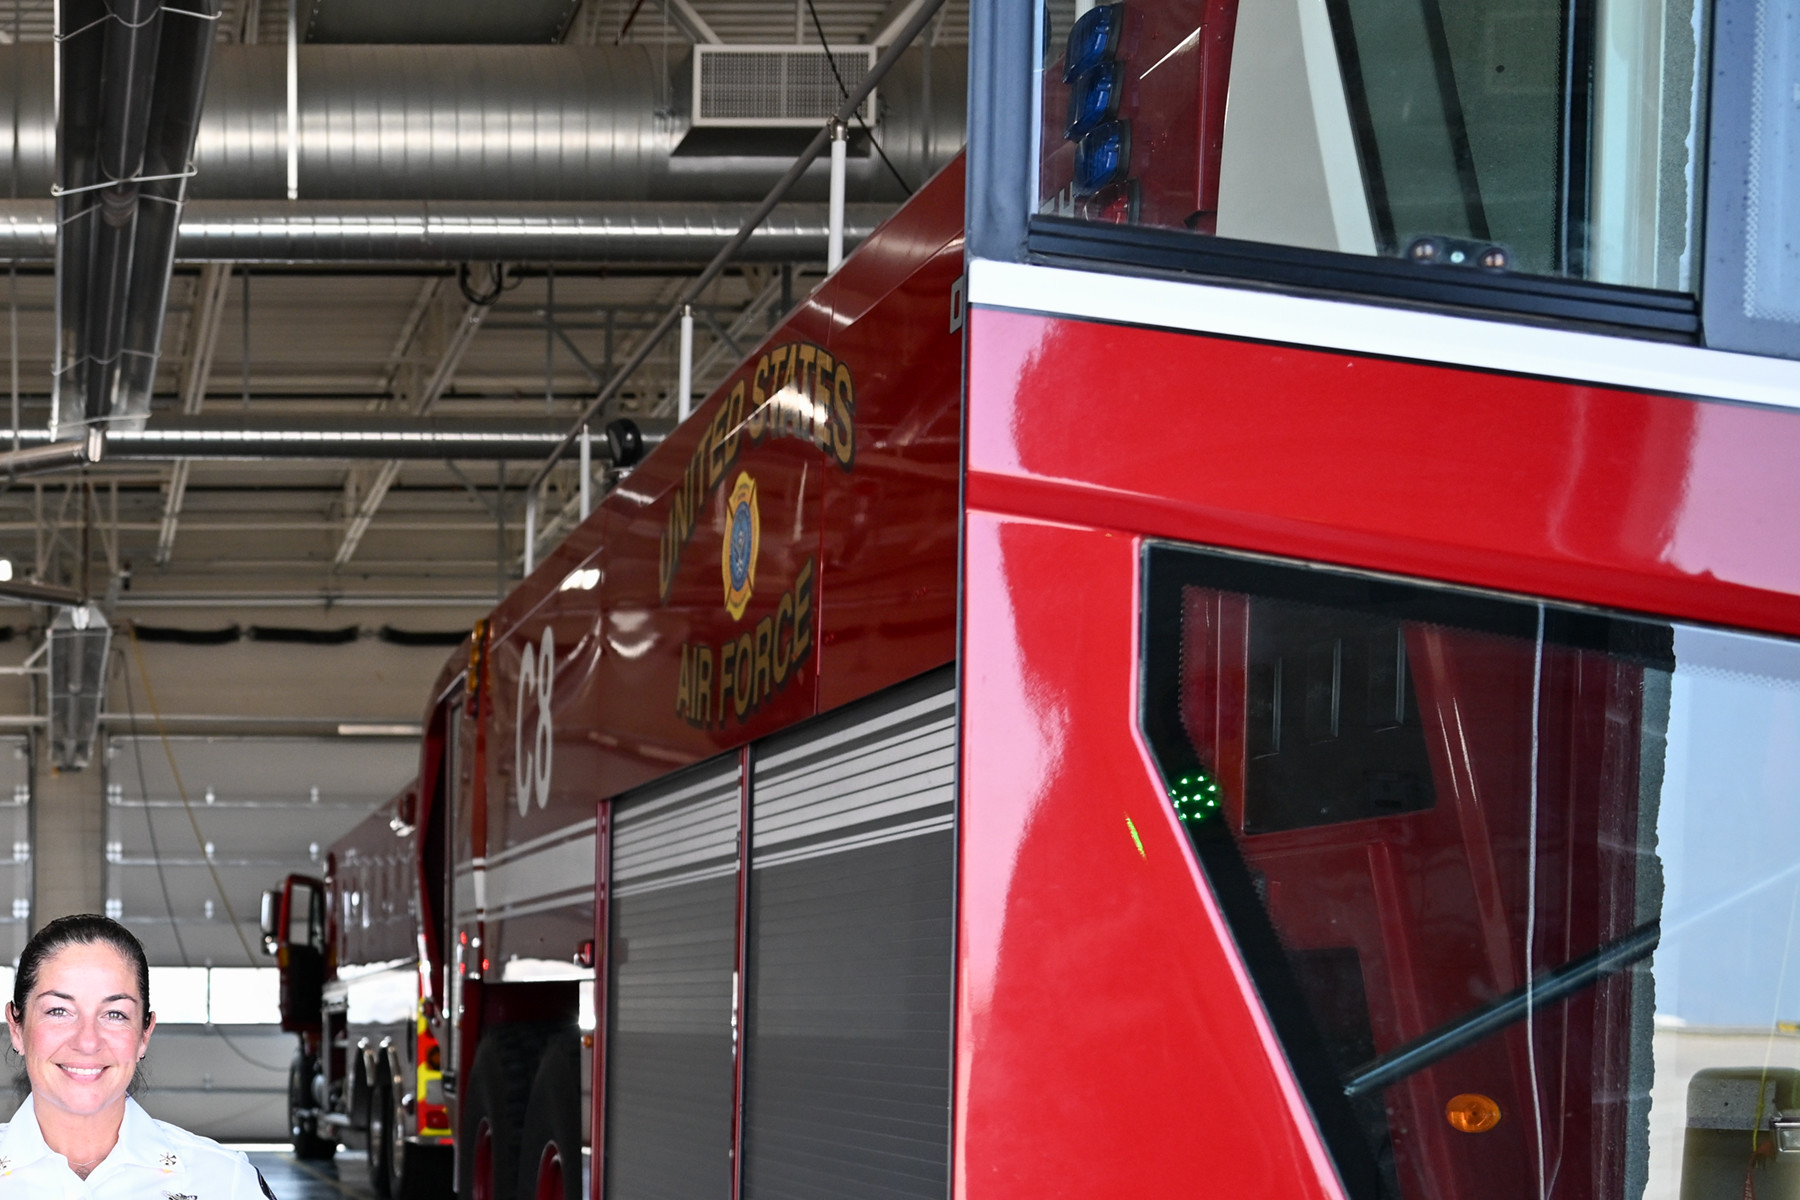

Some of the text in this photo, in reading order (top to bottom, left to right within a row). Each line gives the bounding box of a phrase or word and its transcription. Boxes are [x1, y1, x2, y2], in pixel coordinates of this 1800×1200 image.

[659, 342, 855, 605] UNITED STATES
[516, 625, 554, 818] C8
[676, 556, 814, 729] AIR FORCE
